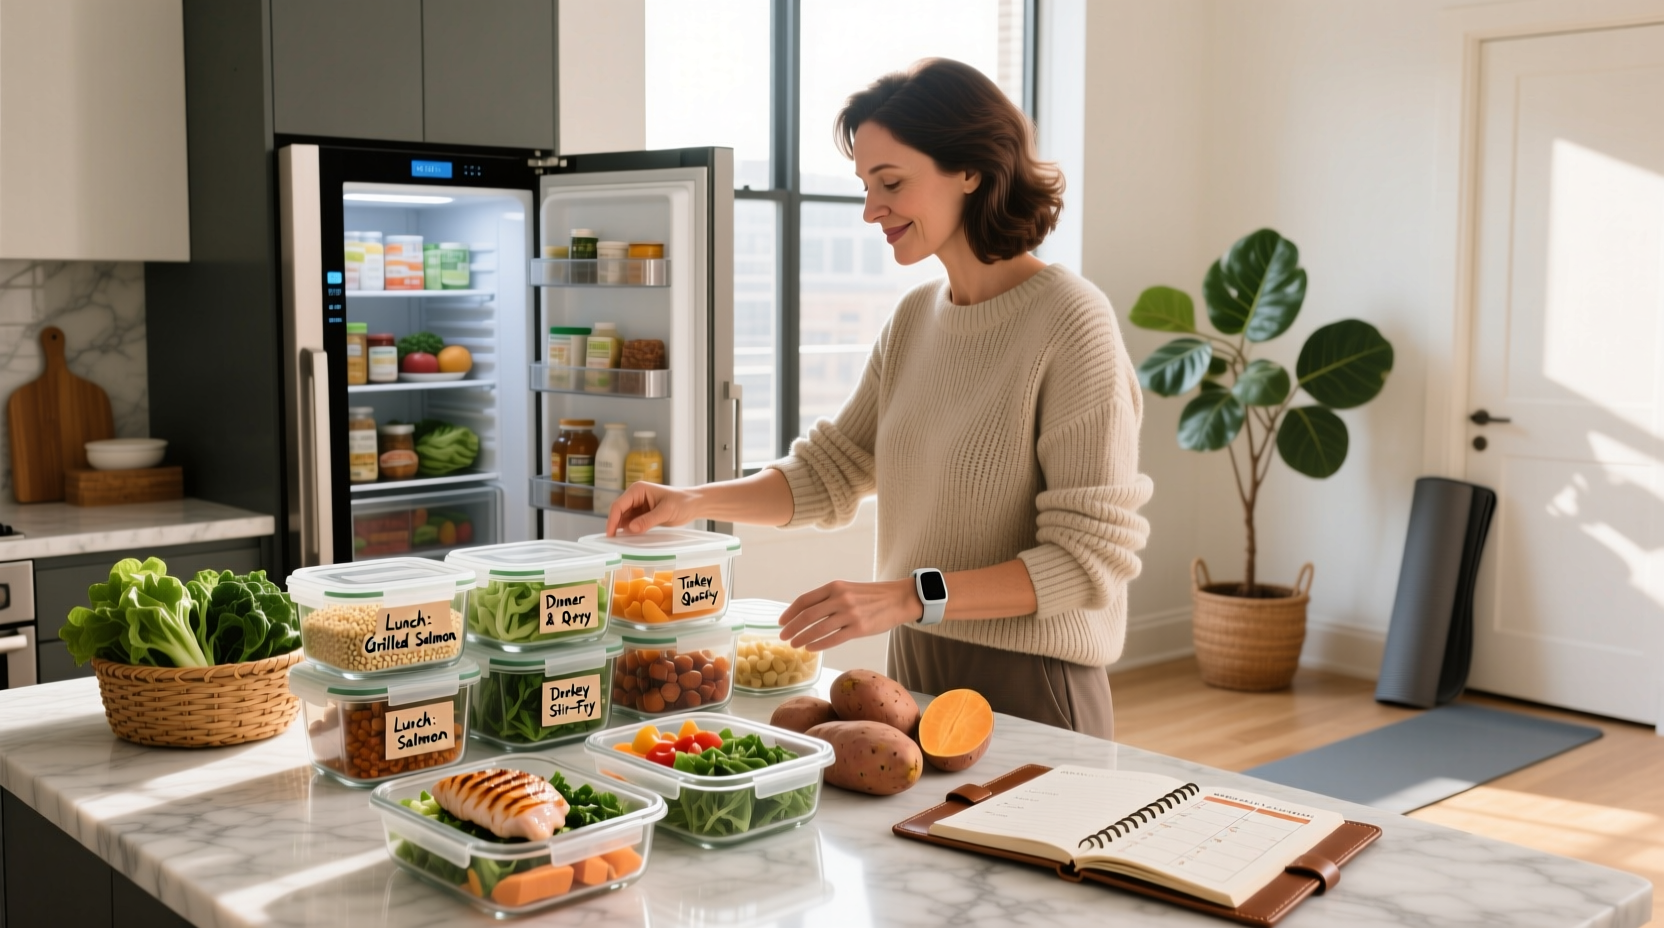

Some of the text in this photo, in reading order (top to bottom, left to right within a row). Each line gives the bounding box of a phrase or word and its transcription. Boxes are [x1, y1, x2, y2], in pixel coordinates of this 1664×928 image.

[385, 609, 432, 631] Lunch:
[364, 631, 457, 654] Grilled Salmon
[397, 730, 448, 750] Salmon
